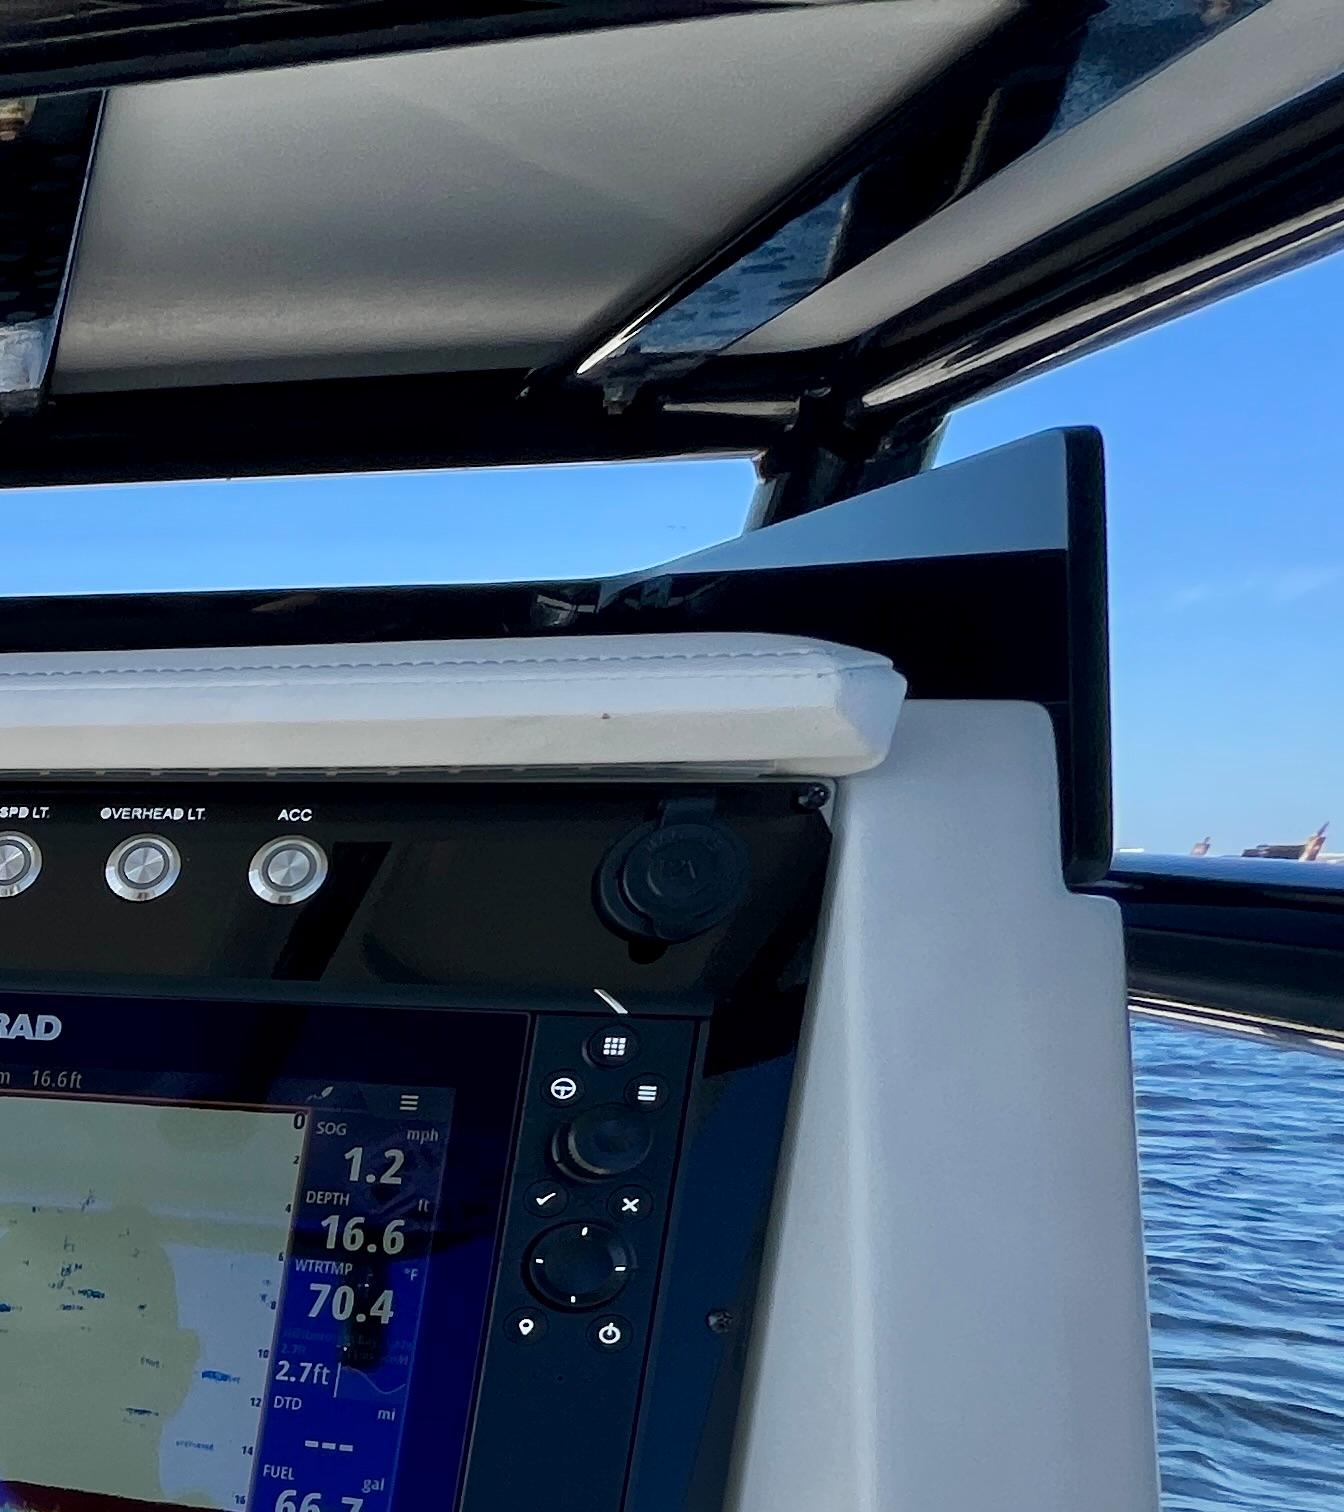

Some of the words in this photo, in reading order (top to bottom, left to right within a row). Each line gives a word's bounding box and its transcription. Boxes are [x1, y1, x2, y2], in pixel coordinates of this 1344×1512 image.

[0, 806, 29, 818] SPD
[100, 807, 184, 820] OVERHEAD
[278, 809, 312, 821] ACC
[293, 1113, 305, 1130] 0
[316, 1121, 347, 1136] SOG
[406, 1128, 439, 1144] mph
[344, 1147, 404, 1185] 1.2
[306, 1190, 350, 1206] DEPTH
[418, 1199, 429, 1212] ft
[321, 1215, 405, 1255] 16.6
[295, 1259, 353, 1275] WTRTMP
[404, 1268, 418, 1281] °F
[308, 1283, 394, 1324] 70.4
[258, 1349, 269, 1358] 10
[275, 1360, 331, 1385] 2.7ft
[250, 1398, 261, 1407] 12
[274, 1396, 302, 1410] DTD
[378, 1409, 395, 1421] mi
[242, 1446, 253, 1455] 14
[263, 1464, 295, 1480] FUEL
[362, 1478, 384, 1492] gal
[235, 1495, 246, 1504] 16
